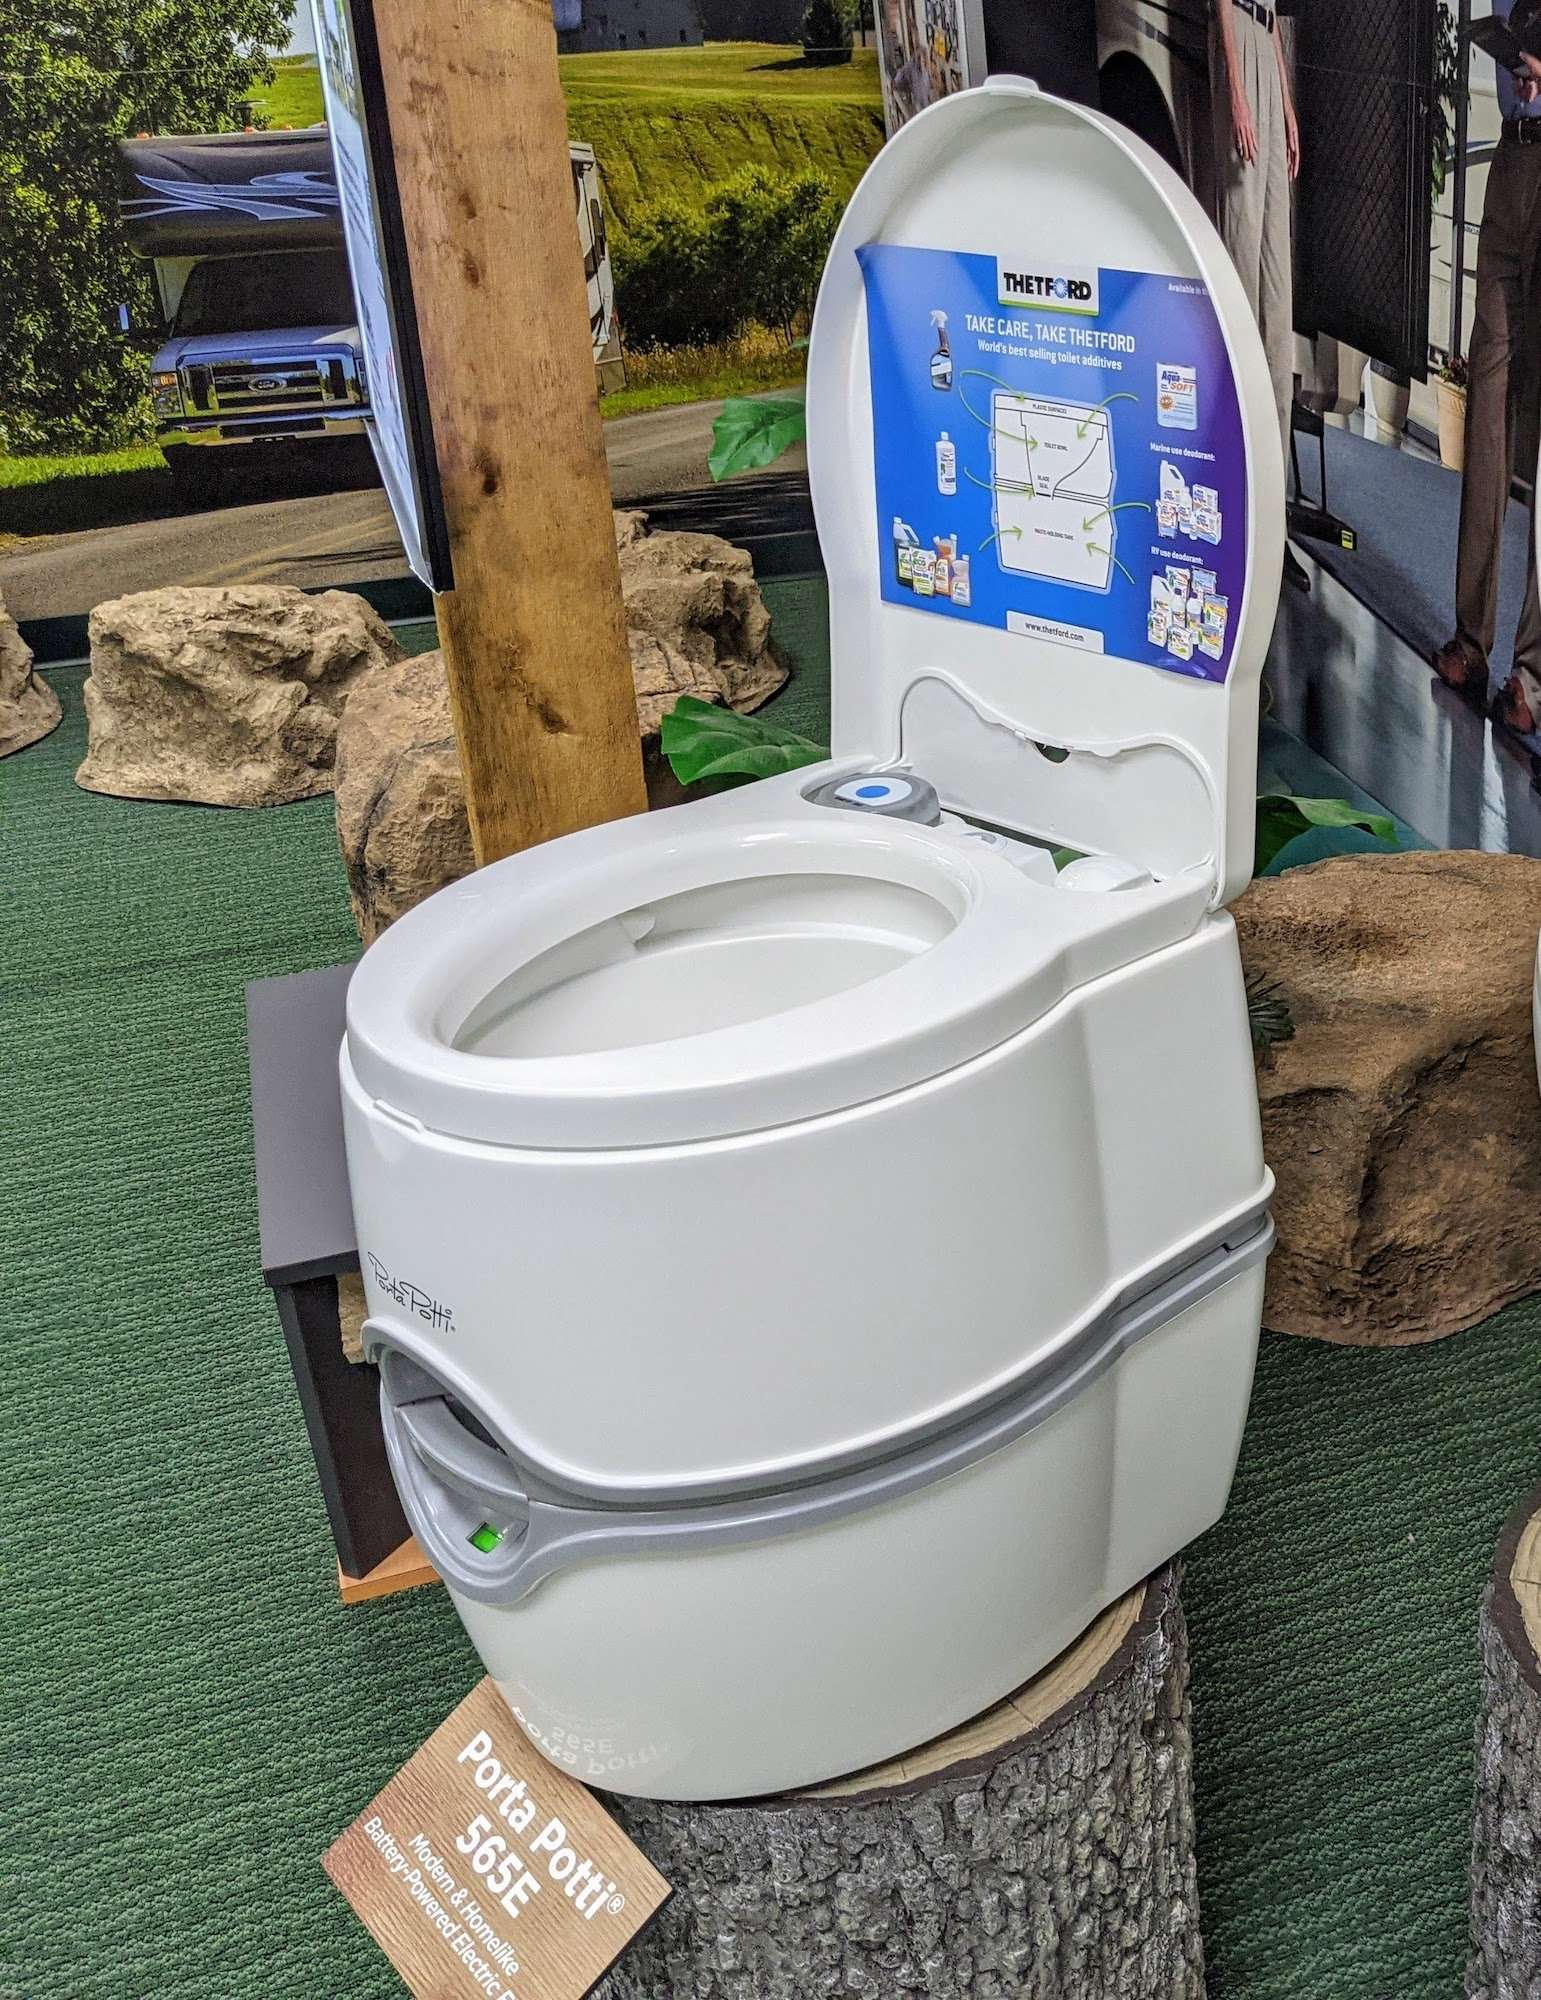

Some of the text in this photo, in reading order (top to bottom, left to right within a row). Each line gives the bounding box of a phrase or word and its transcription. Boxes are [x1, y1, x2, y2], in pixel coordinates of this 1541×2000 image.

[1003, 272, 1092, 301] THETFORD
[965, 314, 1136, 353] TAKE CARE, TAKE THETFORD
[978, 340, 1123, 371] World's best selling toilet additives
[1171, 447, 1182, 456] use
[1160, 549, 1171, 558] use
[1024, 622, 1085, 642] www.thetford.com
[457, 1730, 536, 1834] Porta
[456, 1814, 542, 1919] 565E
[364, 1815, 500, 1996] Battery-Powered Electric
[408, 1832, 455, 1893] Modern
[450, 1888, 468, 1908] &
[459, 1900, 519, 1976] Homelike
